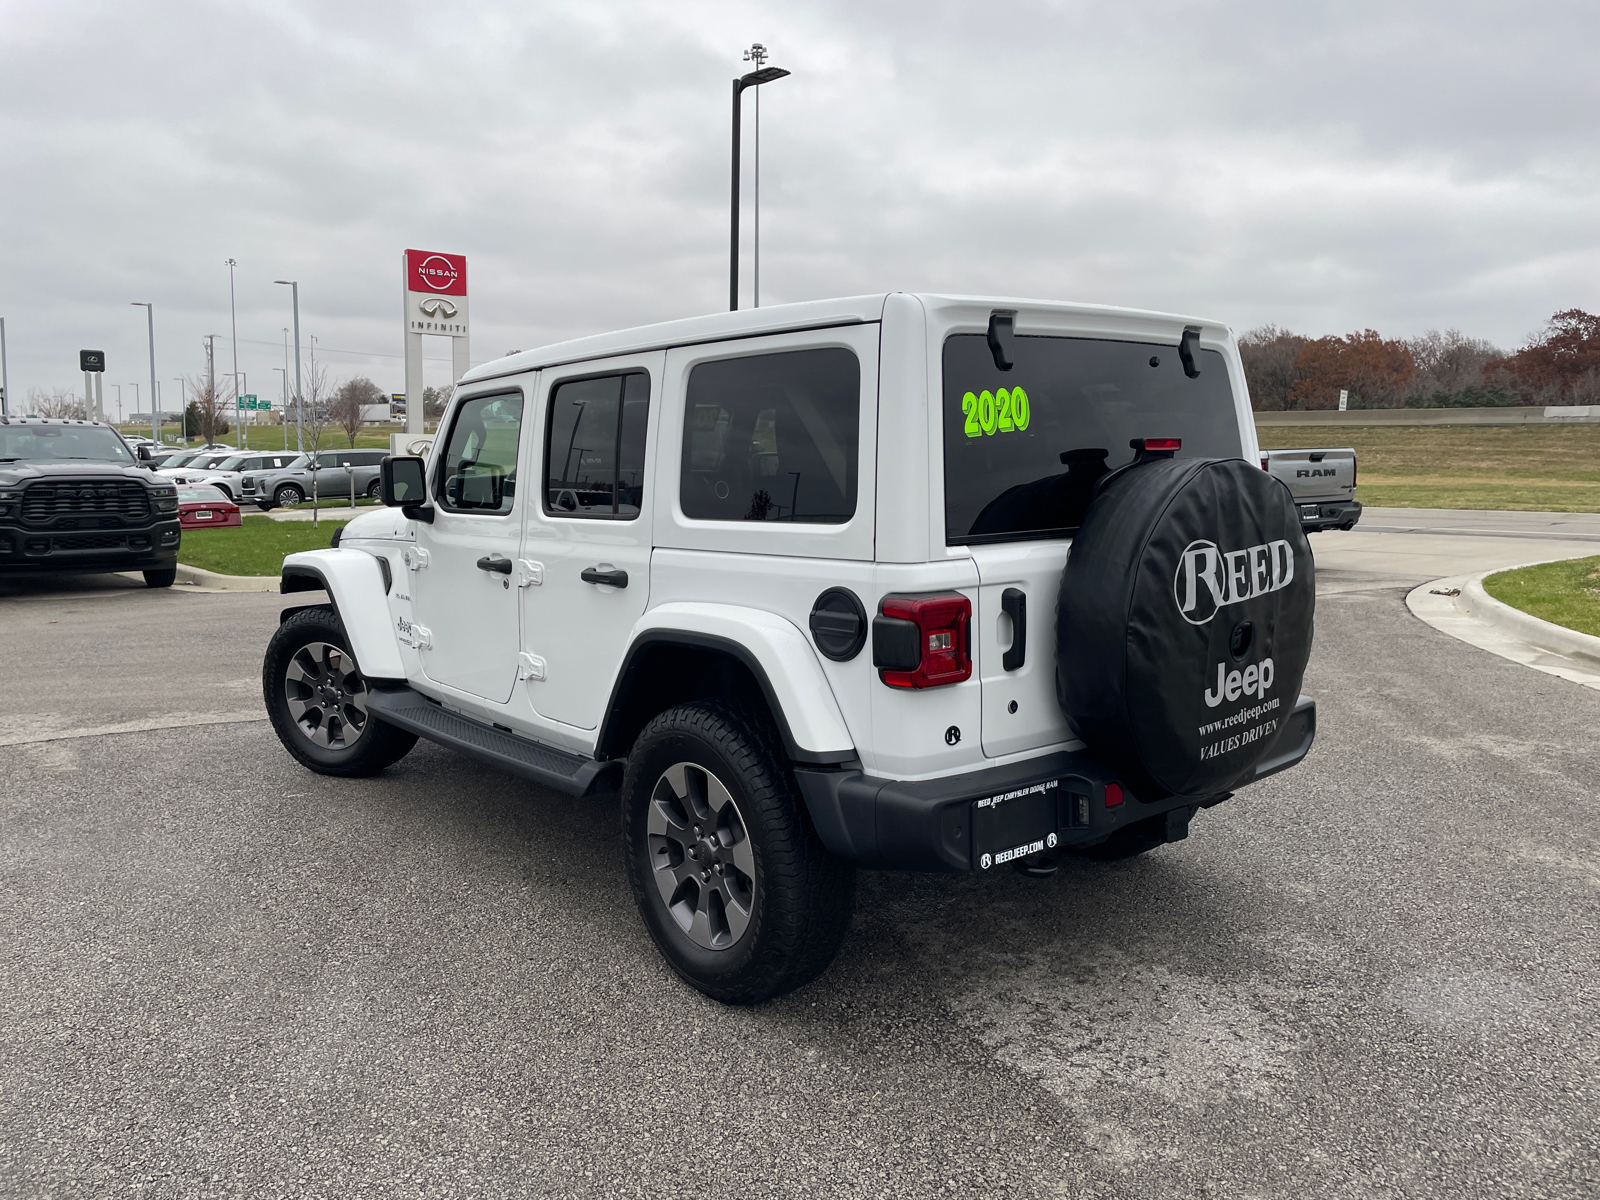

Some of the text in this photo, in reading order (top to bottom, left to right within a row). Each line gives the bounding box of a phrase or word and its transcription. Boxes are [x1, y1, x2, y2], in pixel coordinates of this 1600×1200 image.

[418, 267, 458, 278] NISSAN
[411, 321, 466, 333] INFINITI
[962, 386, 1030, 438] 2020
[1296, 468, 1336, 478] RAM
[57, 489, 118, 498] RAM
[1180, 539, 1294, 615] REED
[1204, 657, 1274, 708] Jeep
[1198, 697, 1280, 737] www.reedjeep.com
[1200, 717, 1279, 761] VALUES DRIVEN
[977, 779, 1058, 808] REED JEEP CHRYSLER DODGE RAM
[995, 840, 1044, 865] REEDJEEP.COM
